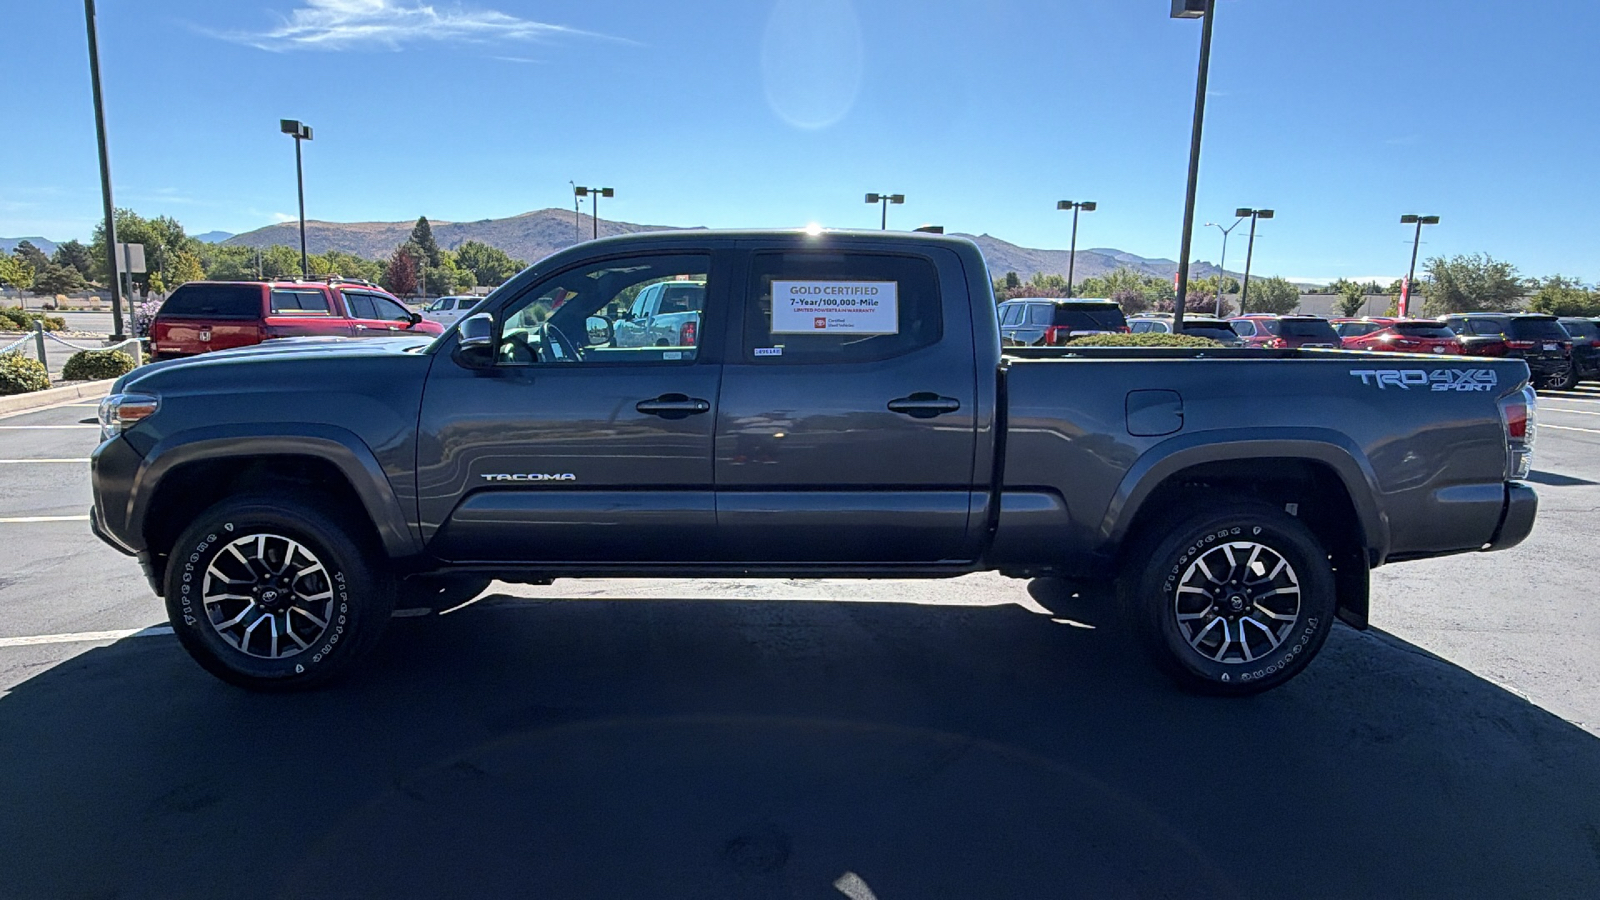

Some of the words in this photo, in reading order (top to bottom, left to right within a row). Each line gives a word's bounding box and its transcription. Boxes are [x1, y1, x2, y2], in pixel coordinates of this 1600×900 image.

[790, 286, 822, 295] GOLD
[823, 286, 879, 295] CERTIFIED
[790, 298, 879, 307] 7-Year/100,000-Mile
[1350, 369, 1430, 391] TRD
[1431, 382, 1498, 392] SPORT
[480, 473, 576, 481] TACOMA
[181, 534, 217, 626] Firestone
[312, 571, 348, 663] Firestone
